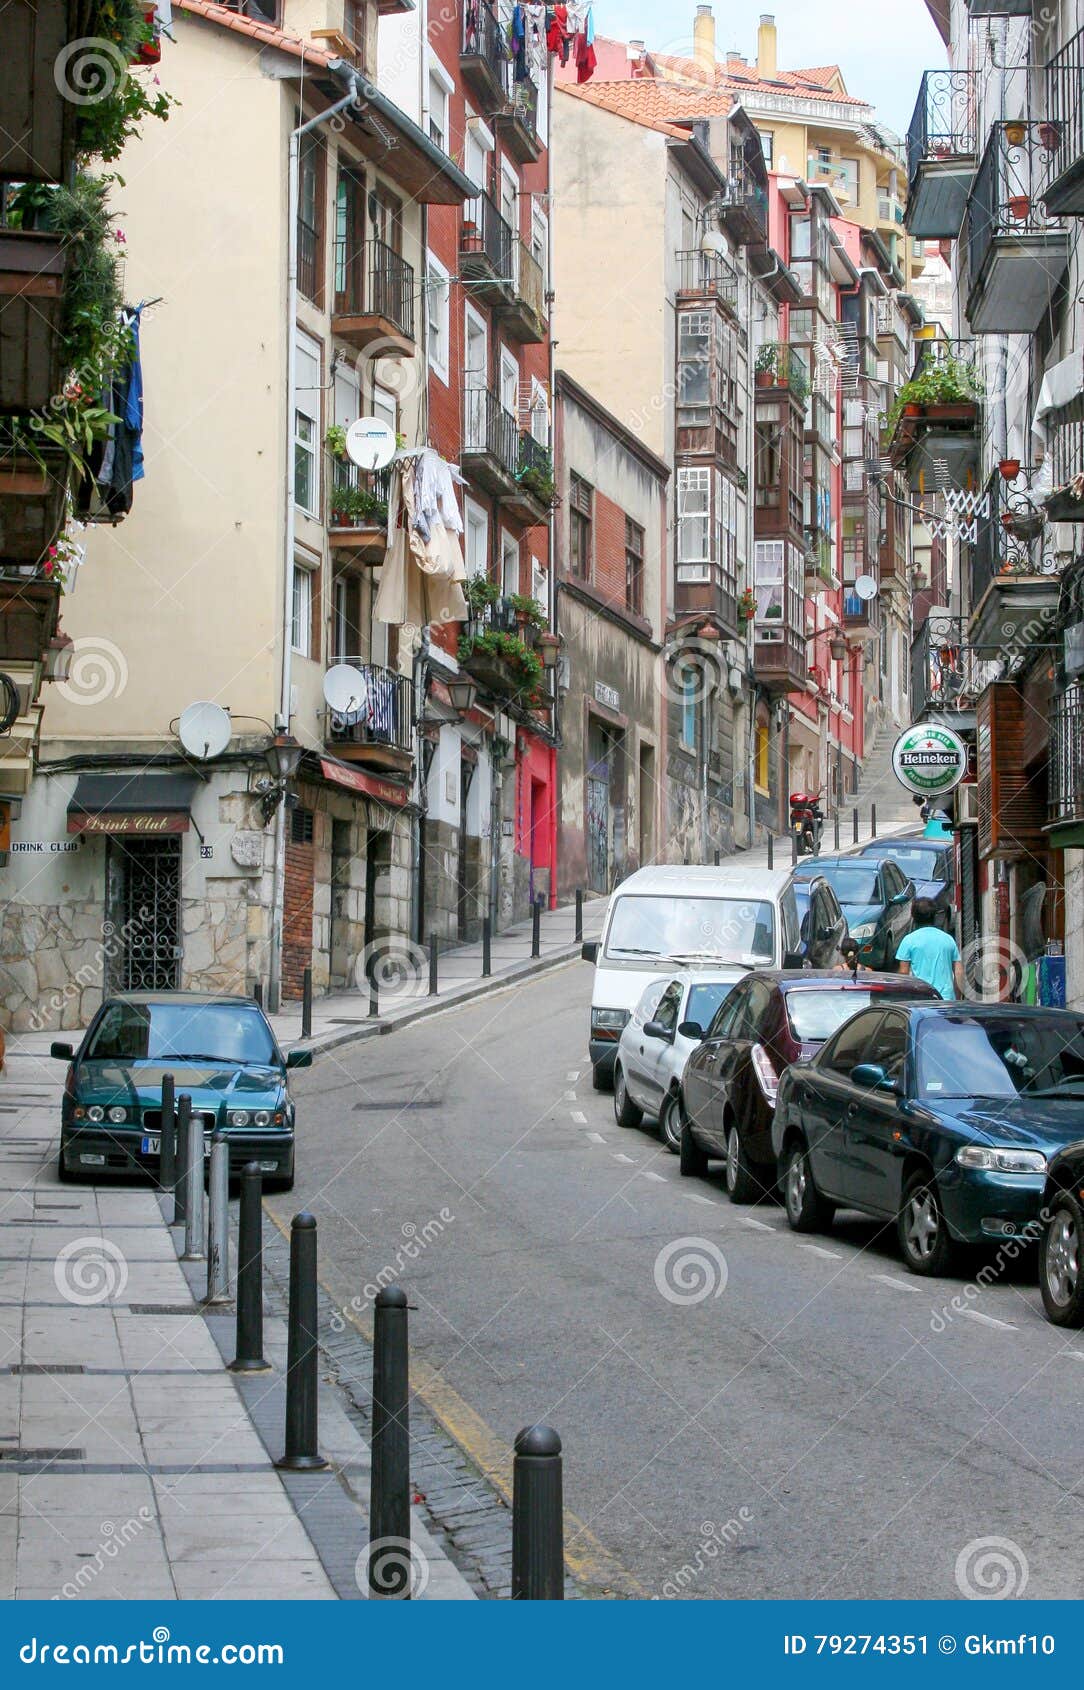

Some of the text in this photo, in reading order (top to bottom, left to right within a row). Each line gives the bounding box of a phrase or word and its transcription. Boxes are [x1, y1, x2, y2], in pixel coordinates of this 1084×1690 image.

[903, 753, 957, 764] Heineken
[86, 815, 169, 830] Drink Club
[12, 842, 78, 852] DRINK CLUB
